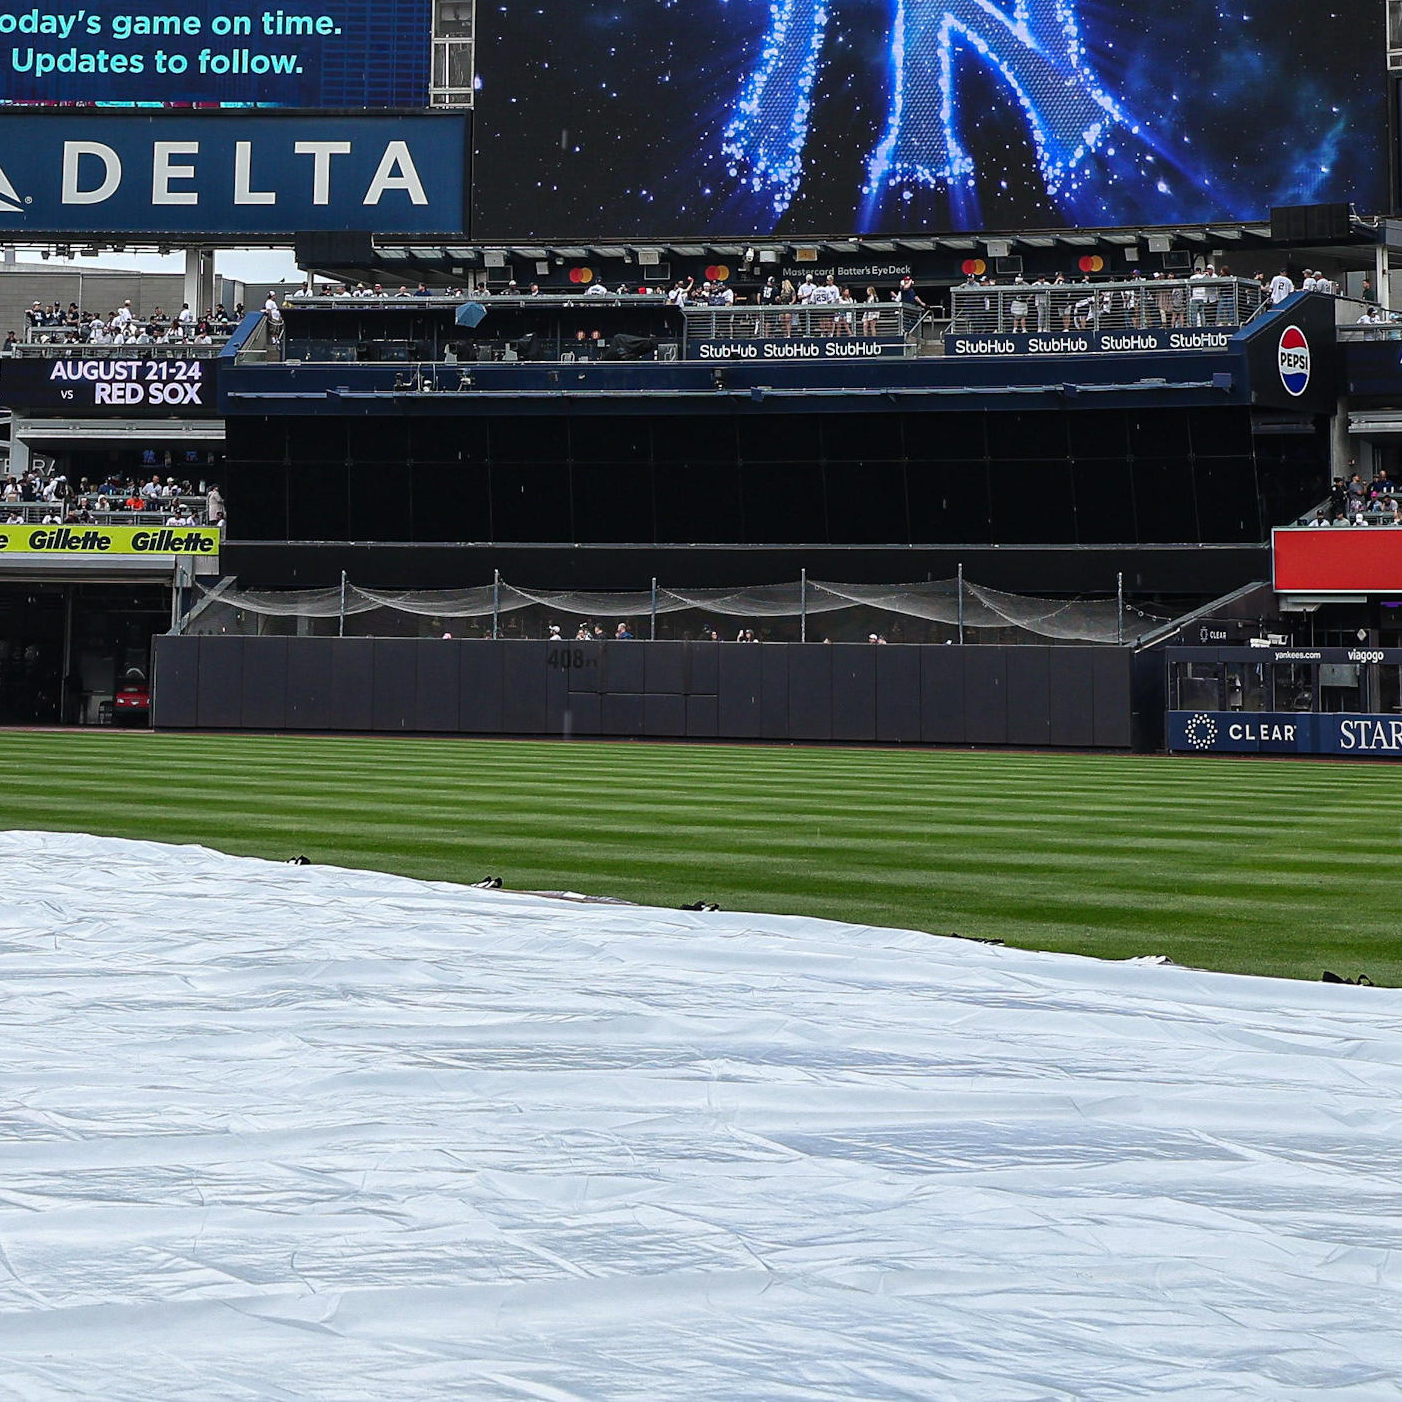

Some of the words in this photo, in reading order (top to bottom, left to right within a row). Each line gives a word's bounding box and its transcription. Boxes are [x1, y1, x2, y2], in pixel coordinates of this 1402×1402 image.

[112, 14, 201, 40] game
[212, 14, 251, 36] on
[261, 10, 343, 36] time.
[11, 48, 145, 78] Updates
[154, 51, 188, 74] to
[198, 48, 304, 74] follow.
[61, 140, 428, 206] DELTA
[837, 266, 871, 276] Batter's
[872, 266, 888, 276] Eye
[888, 265, 911, 274] Deck
[763, 343, 820, 358] StubHub
[955, 338, 1015, 355] StubHub
[1100, 334, 1157, 351] StubHub
[50, 360, 141, 380] AUGUST
[145, 360, 202, 380] 21-24
[1280, 351, 1308, 370] PEPSI
[94, 383, 146, 405] RED
[148, 383, 202, 406] SOX
[131, 529, 214, 552] Gillette
[1209, 629, 1227, 640] CLEAR
[1275, 651, 1321, 661] yankees.com
[1348, 648, 1384, 664] viagogo
